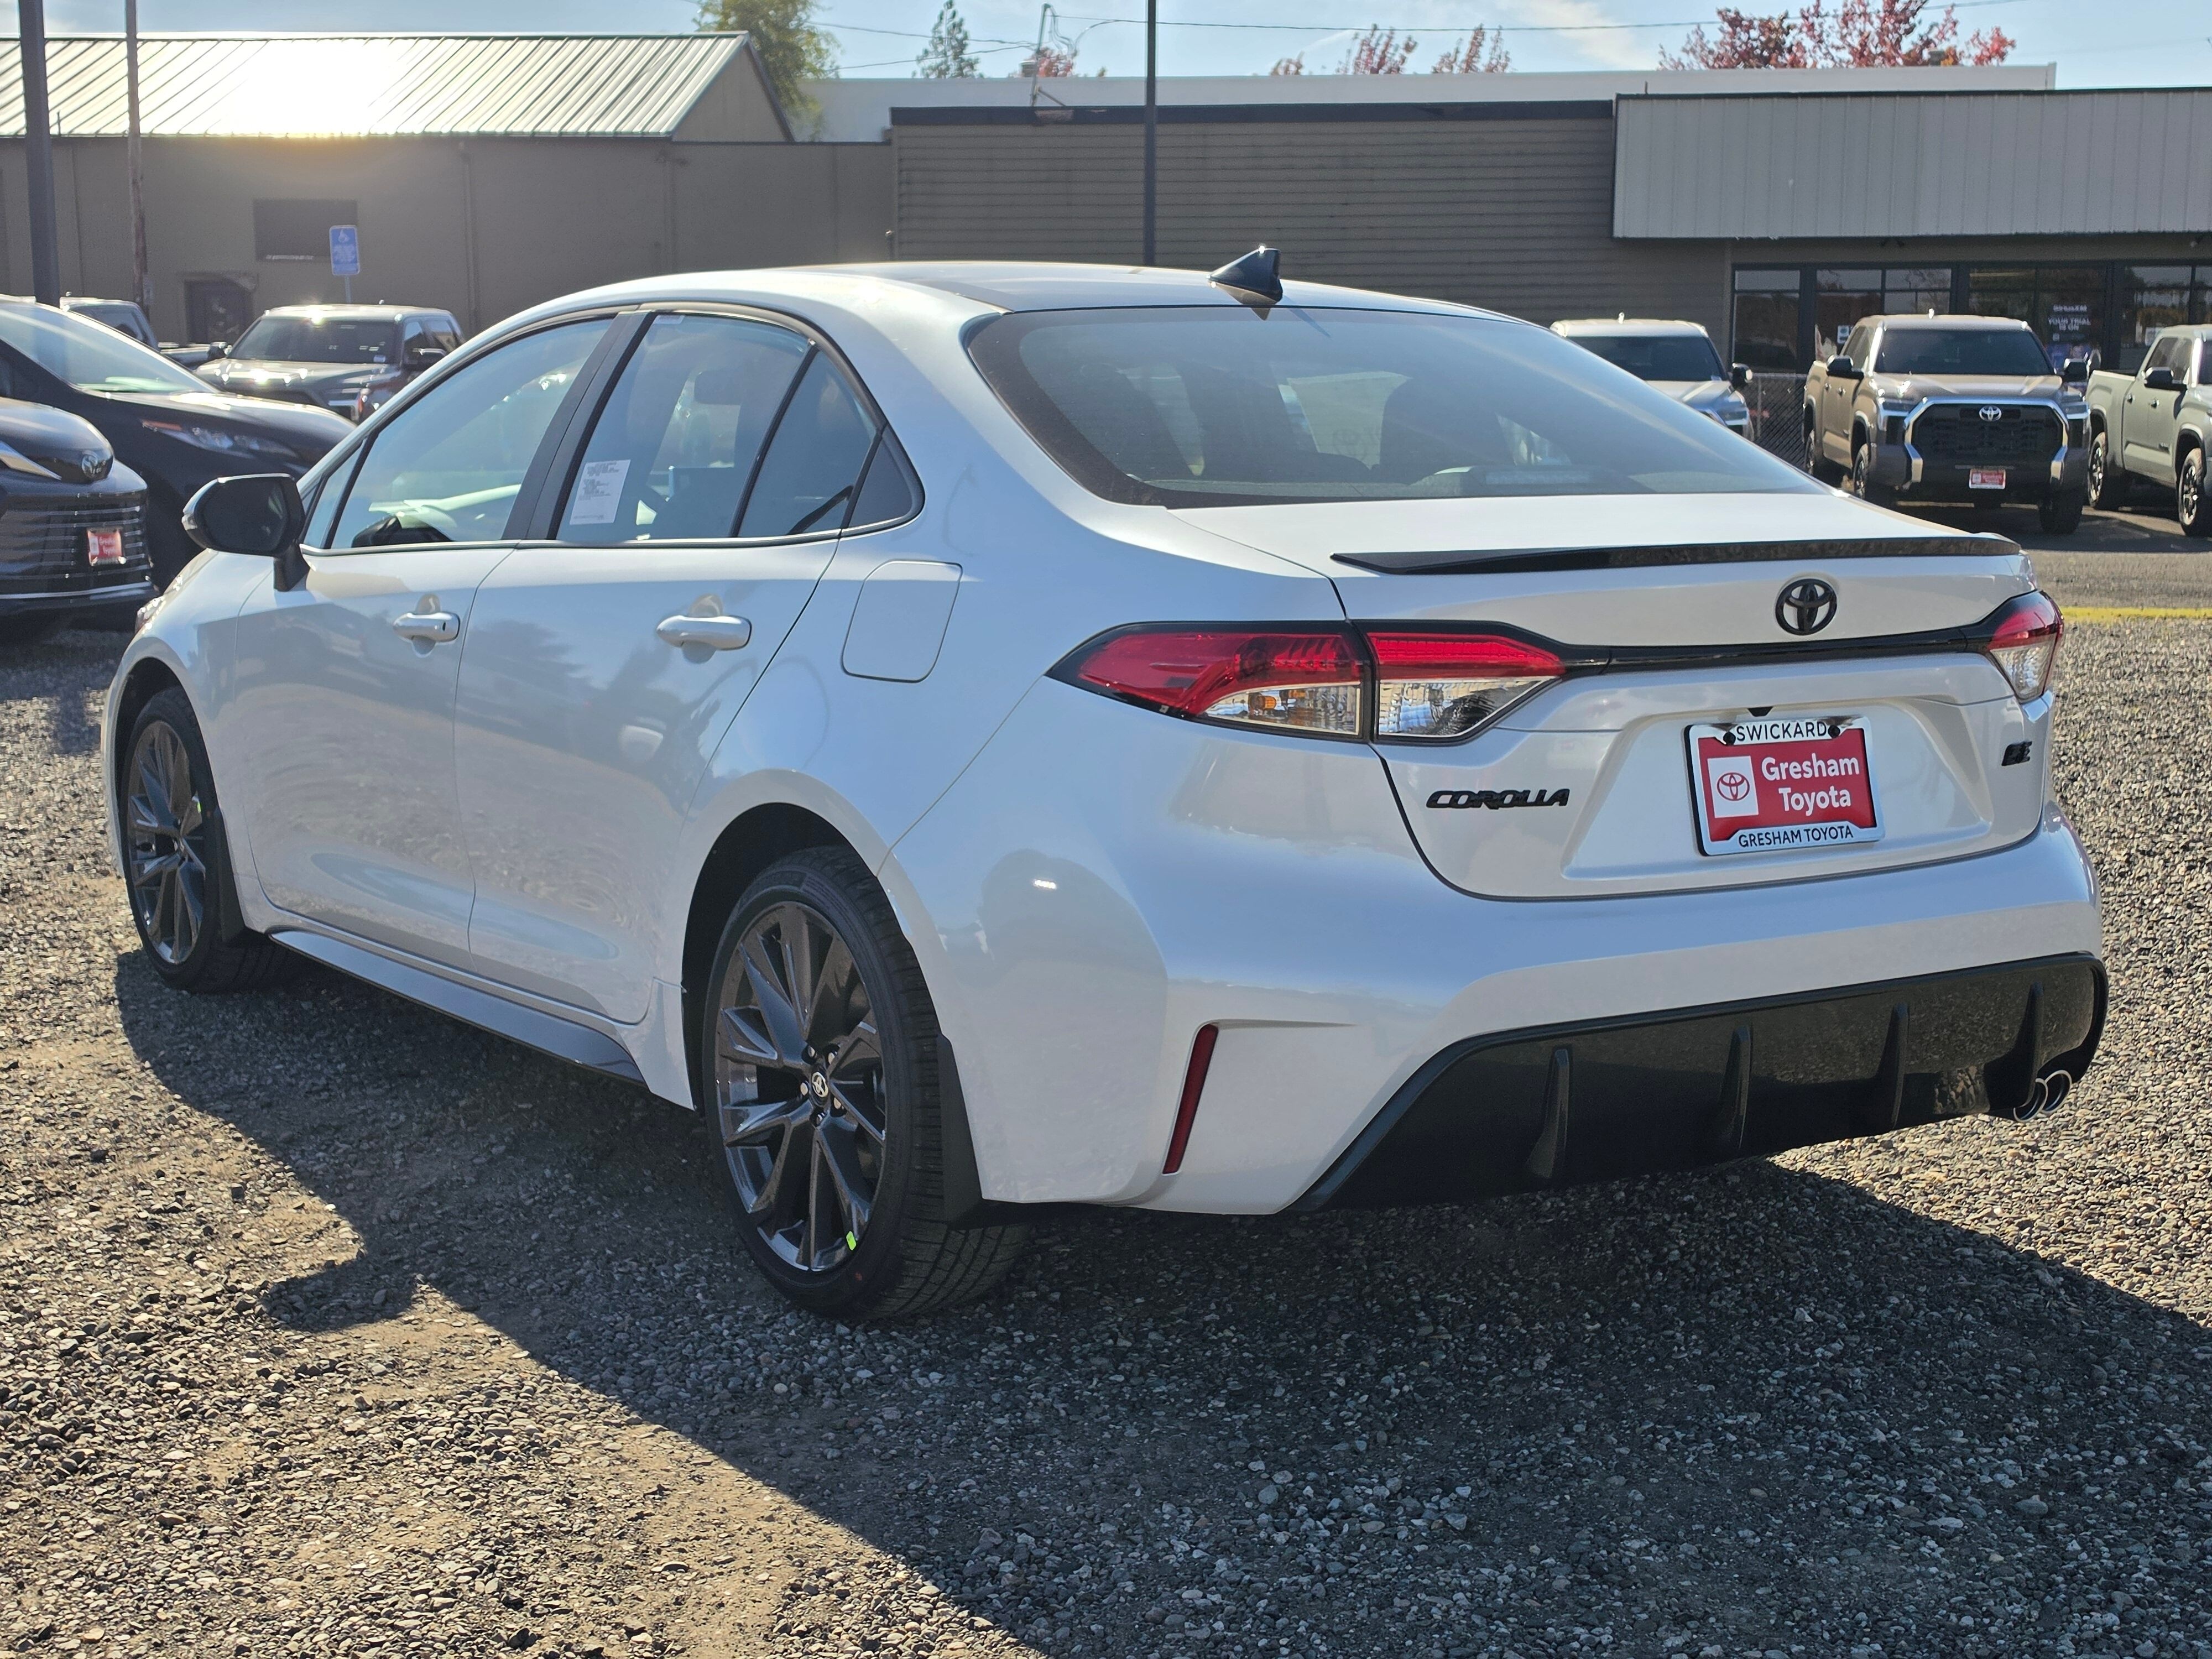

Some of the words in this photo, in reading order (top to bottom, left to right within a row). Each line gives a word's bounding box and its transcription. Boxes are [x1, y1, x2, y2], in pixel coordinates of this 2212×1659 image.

[1736, 721, 1827, 741] SWICKARD
[1761, 753, 1859, 781] Gresham
[1426, 789, 1570, 810] COROLLA
[1778, 785, 1851, 816] Toyota
[1739, 830, 1802, 847] GRESHAM
[1804, 825, 1854, 842] TOYOTA
